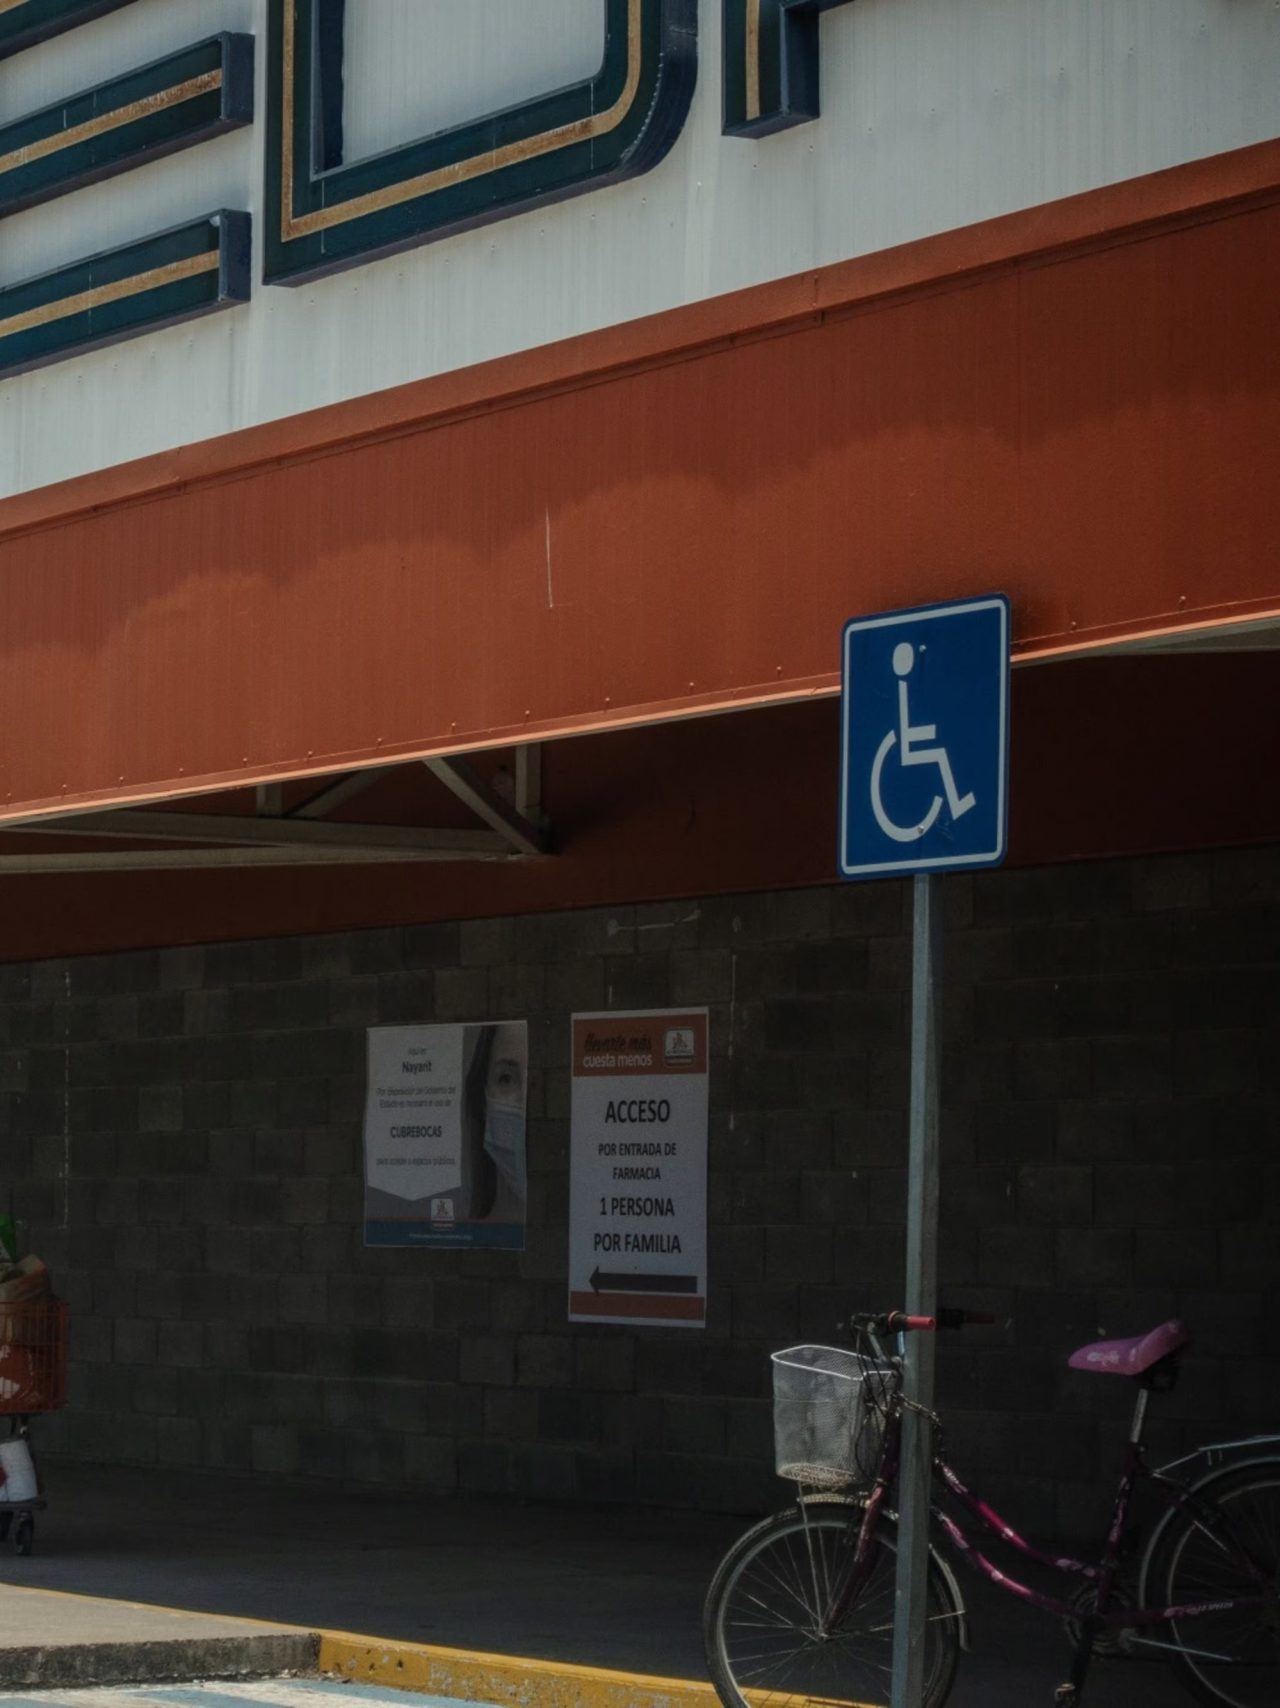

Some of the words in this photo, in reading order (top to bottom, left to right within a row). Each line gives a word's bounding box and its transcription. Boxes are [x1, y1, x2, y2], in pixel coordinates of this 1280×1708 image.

[583, 1053, 615, 1068] cuesta
[617, 1054, 653, 1068] menos
[604, 1099, 671, 1123] ACCESO
[390, 1125, 442, 1138] CUBREBOCAS
[598, 1143, 617, 1156] POR
[619, 1143, 662, 1156] ENTRADA
[664, 1142, 677, 1156] DE
[612, 1167, 661, 1180] FARMACIA
[600, 1197, 607, 1216] 1
[611, 1197, 675, 1217] PERSONA
[593, 1233, 621, 1252] POR
[624, 1233, 682, 1254] FAMILIA
